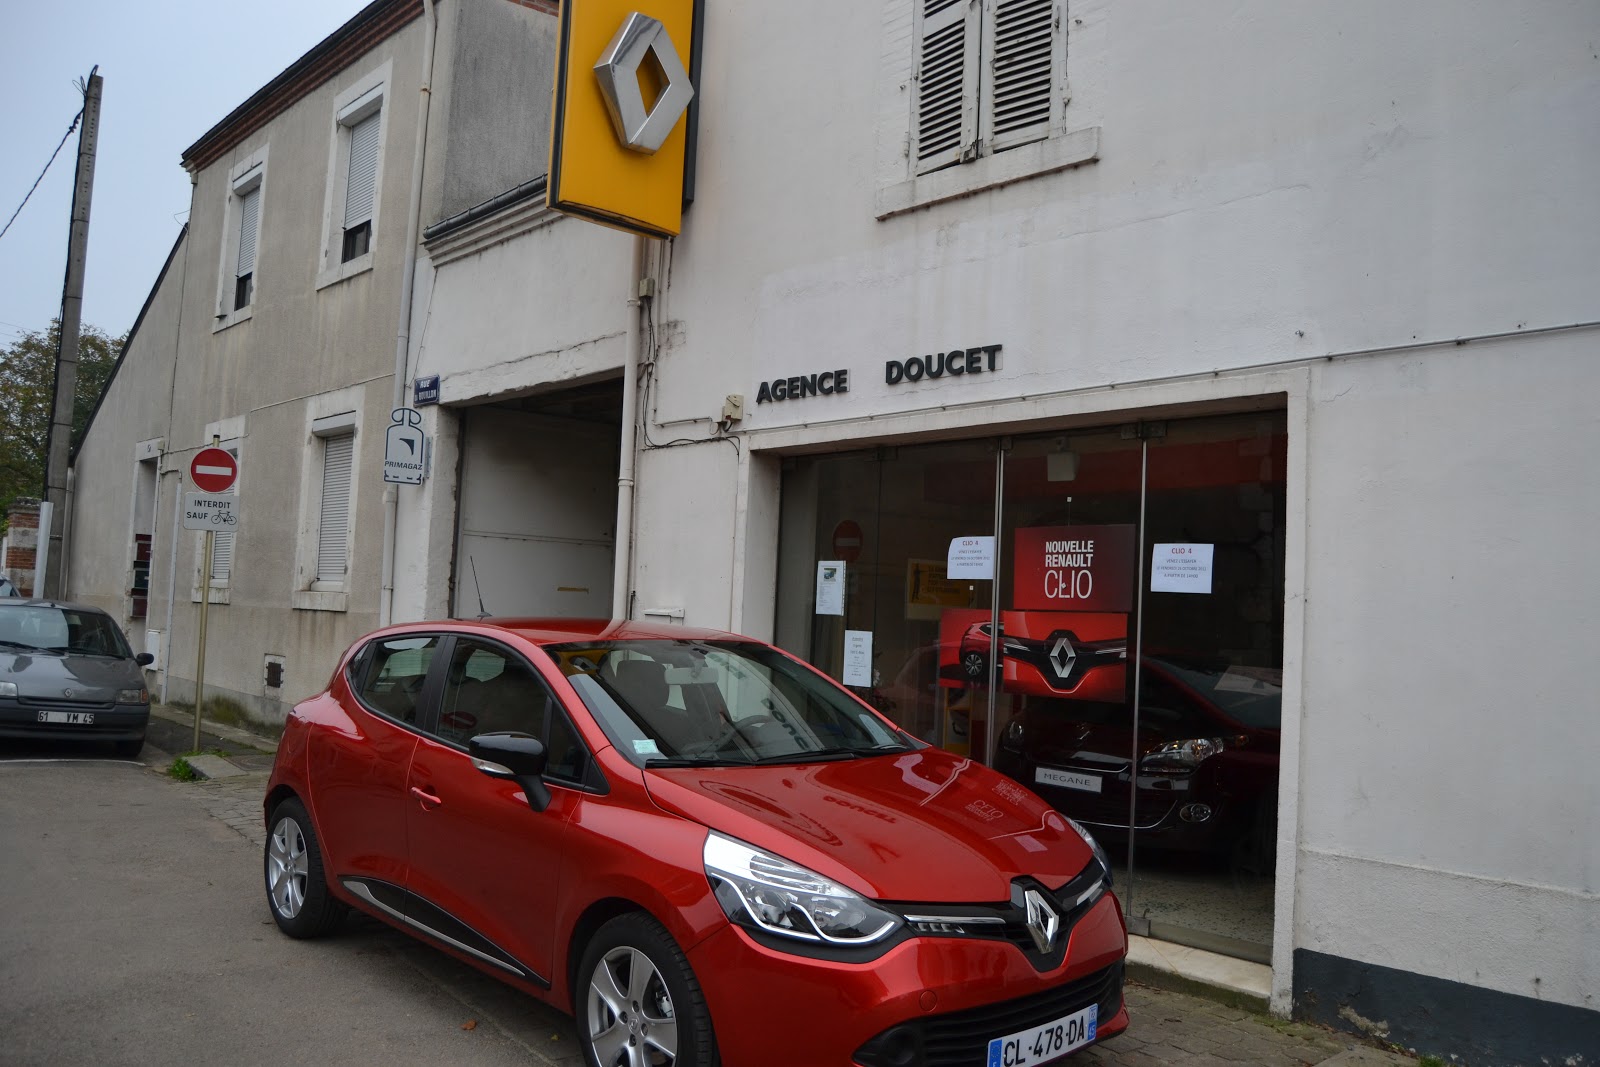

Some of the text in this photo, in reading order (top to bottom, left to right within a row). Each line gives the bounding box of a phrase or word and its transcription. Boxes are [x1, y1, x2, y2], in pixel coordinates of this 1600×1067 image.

[756, 344, 1002, 404] AGENCE DOUCET
[384, 461, 423, 470] PRIMAGAZ
[194, 499, 231, 509] INTERDIT
[186, 511, 208, 519] SAUF
[1045, 540, 1094, 553] NOUVELLE
[1045, 553, 1094, 567] RENAULT
[1044, 569, 1093, 598] CLIO
[83, 714, 94, 723] 45
[1043, 773, 1091, 786] MEGANE
[1088, 1025, 1095, 1037] 45
